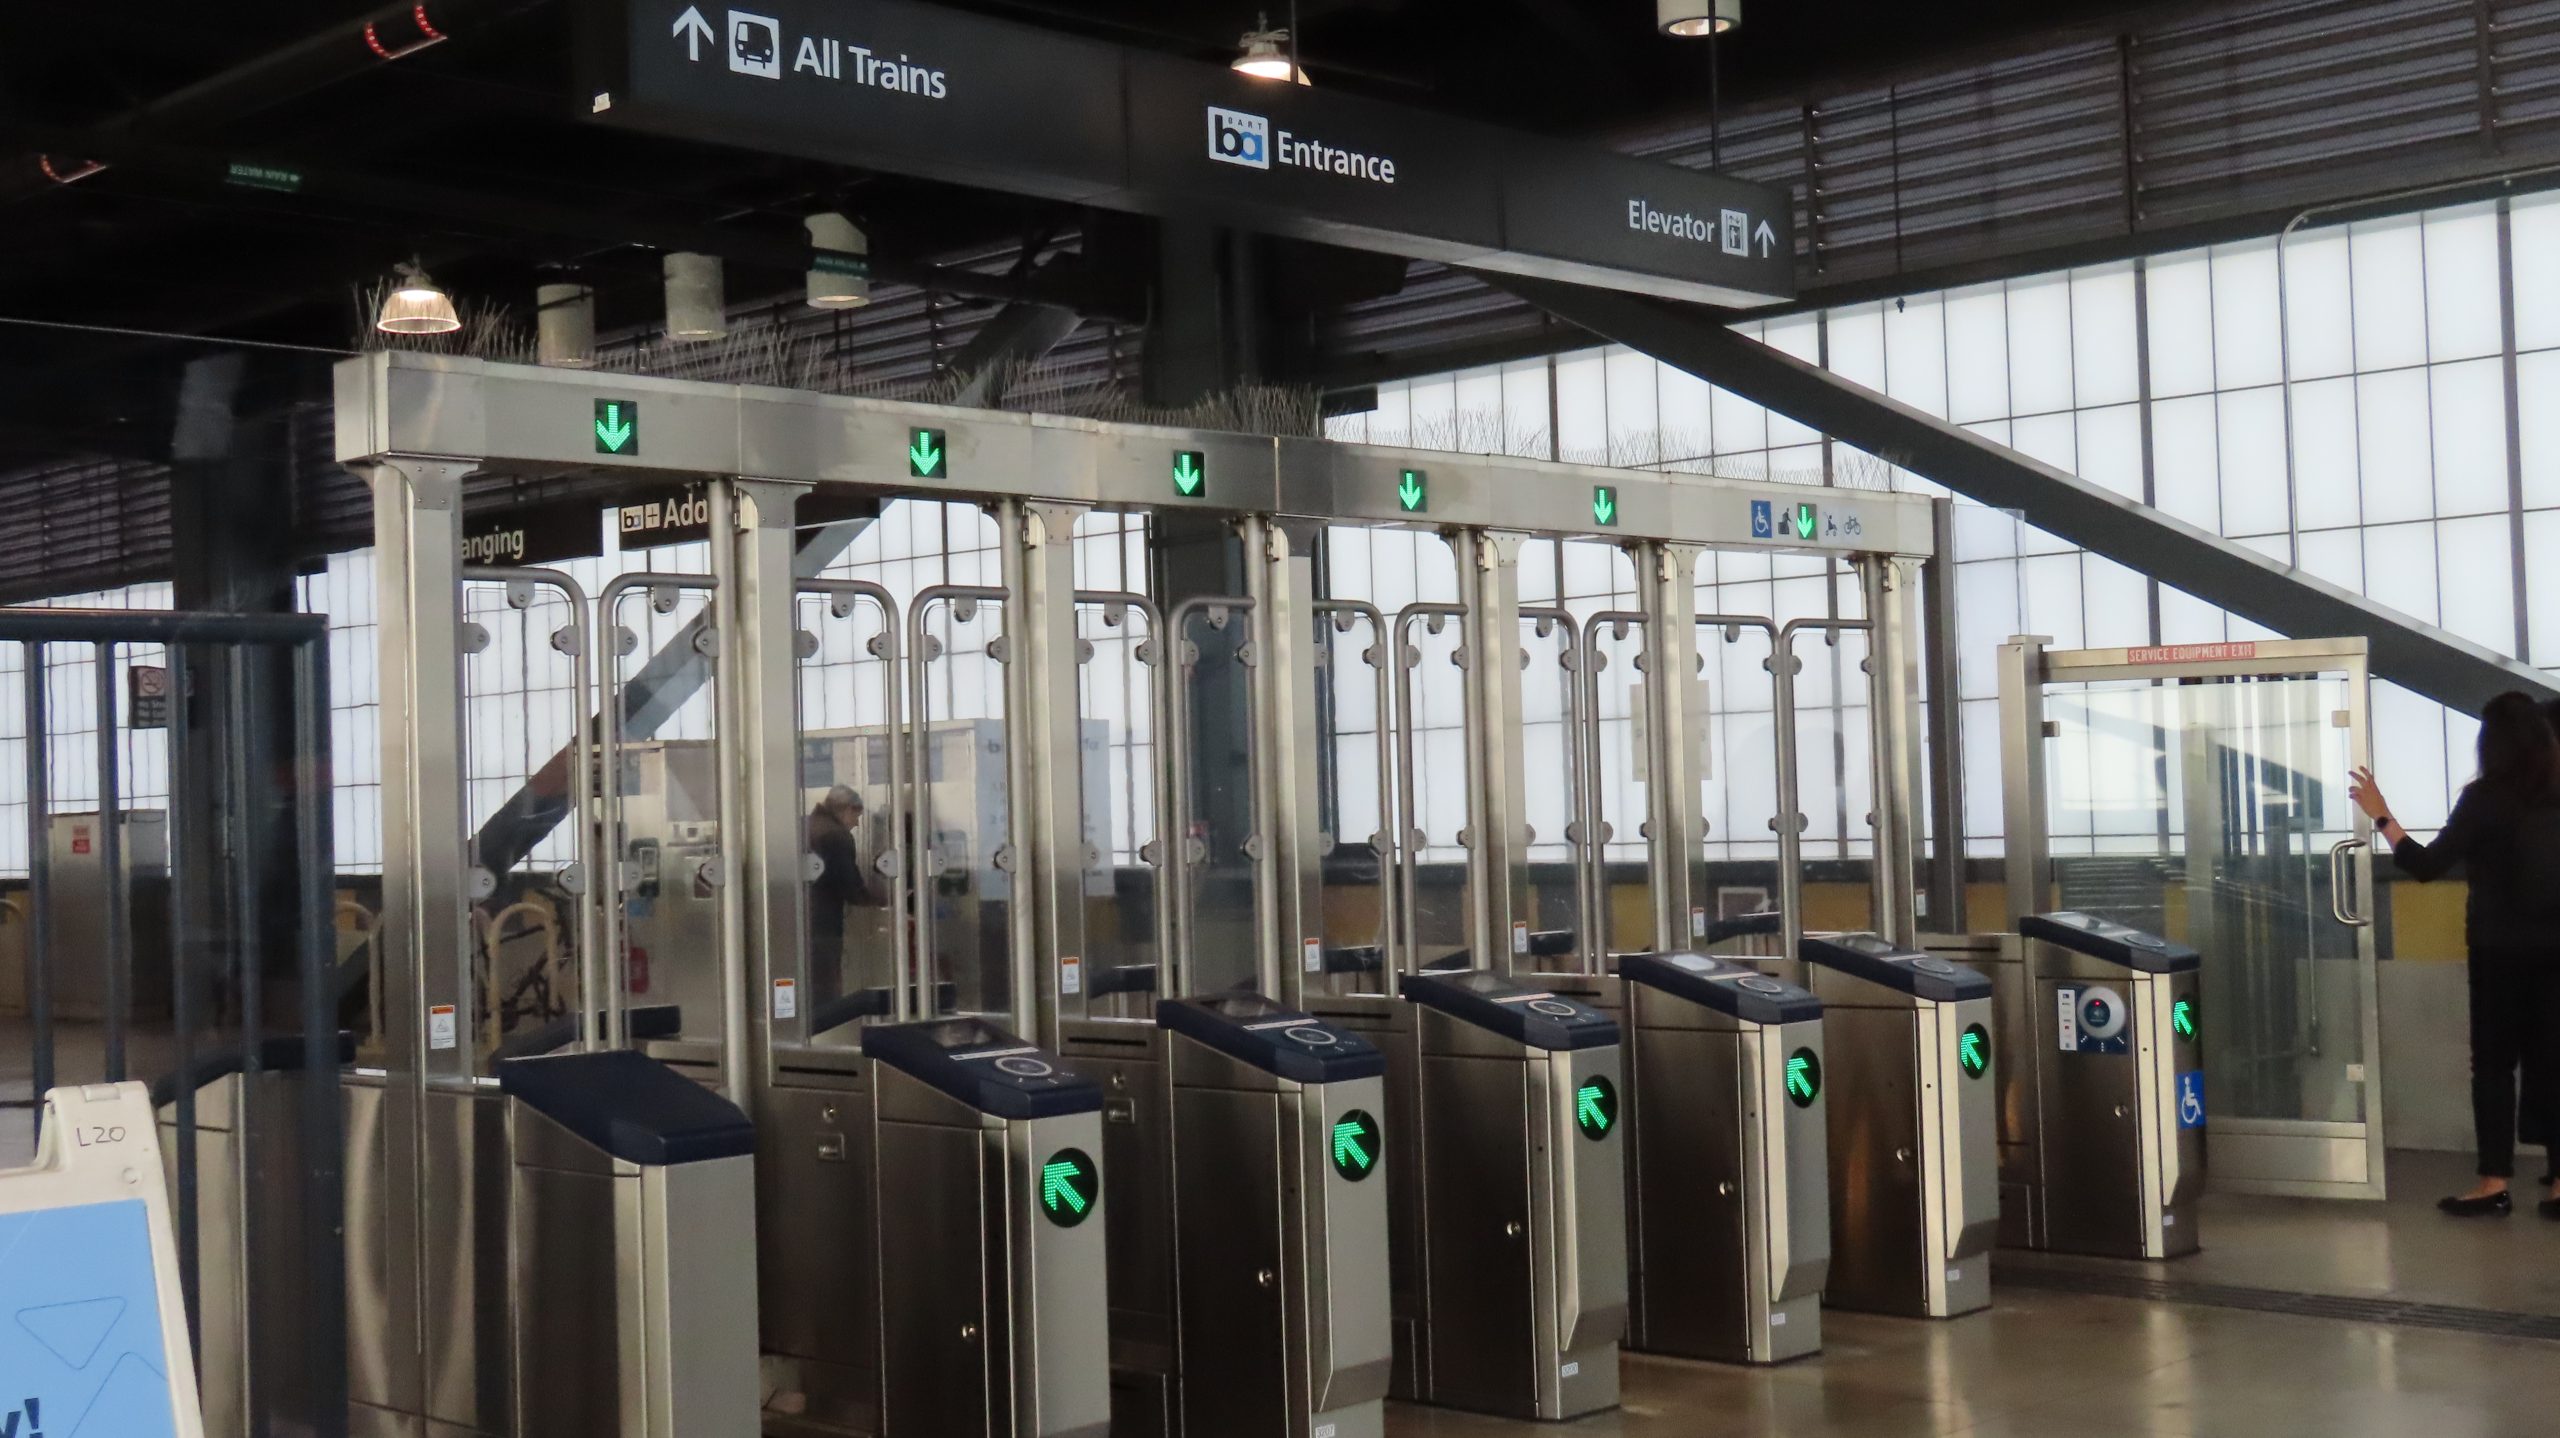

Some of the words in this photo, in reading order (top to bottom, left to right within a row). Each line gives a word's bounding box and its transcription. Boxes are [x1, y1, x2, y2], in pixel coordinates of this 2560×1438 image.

[793, 36, 840, 79] All
[848, 45, 947, 98] Trains
[1277, 130, 1396, 184] Entrance
[1628, 199, 1716, 243] Elevator
[2129, 646, 2170, 663] SERVICE
[2172, 643, 2229, 661] EQUIPMENT
[2231, 642, 2253, 658] EXIT
[76, 1126, 126, 1147] L20
